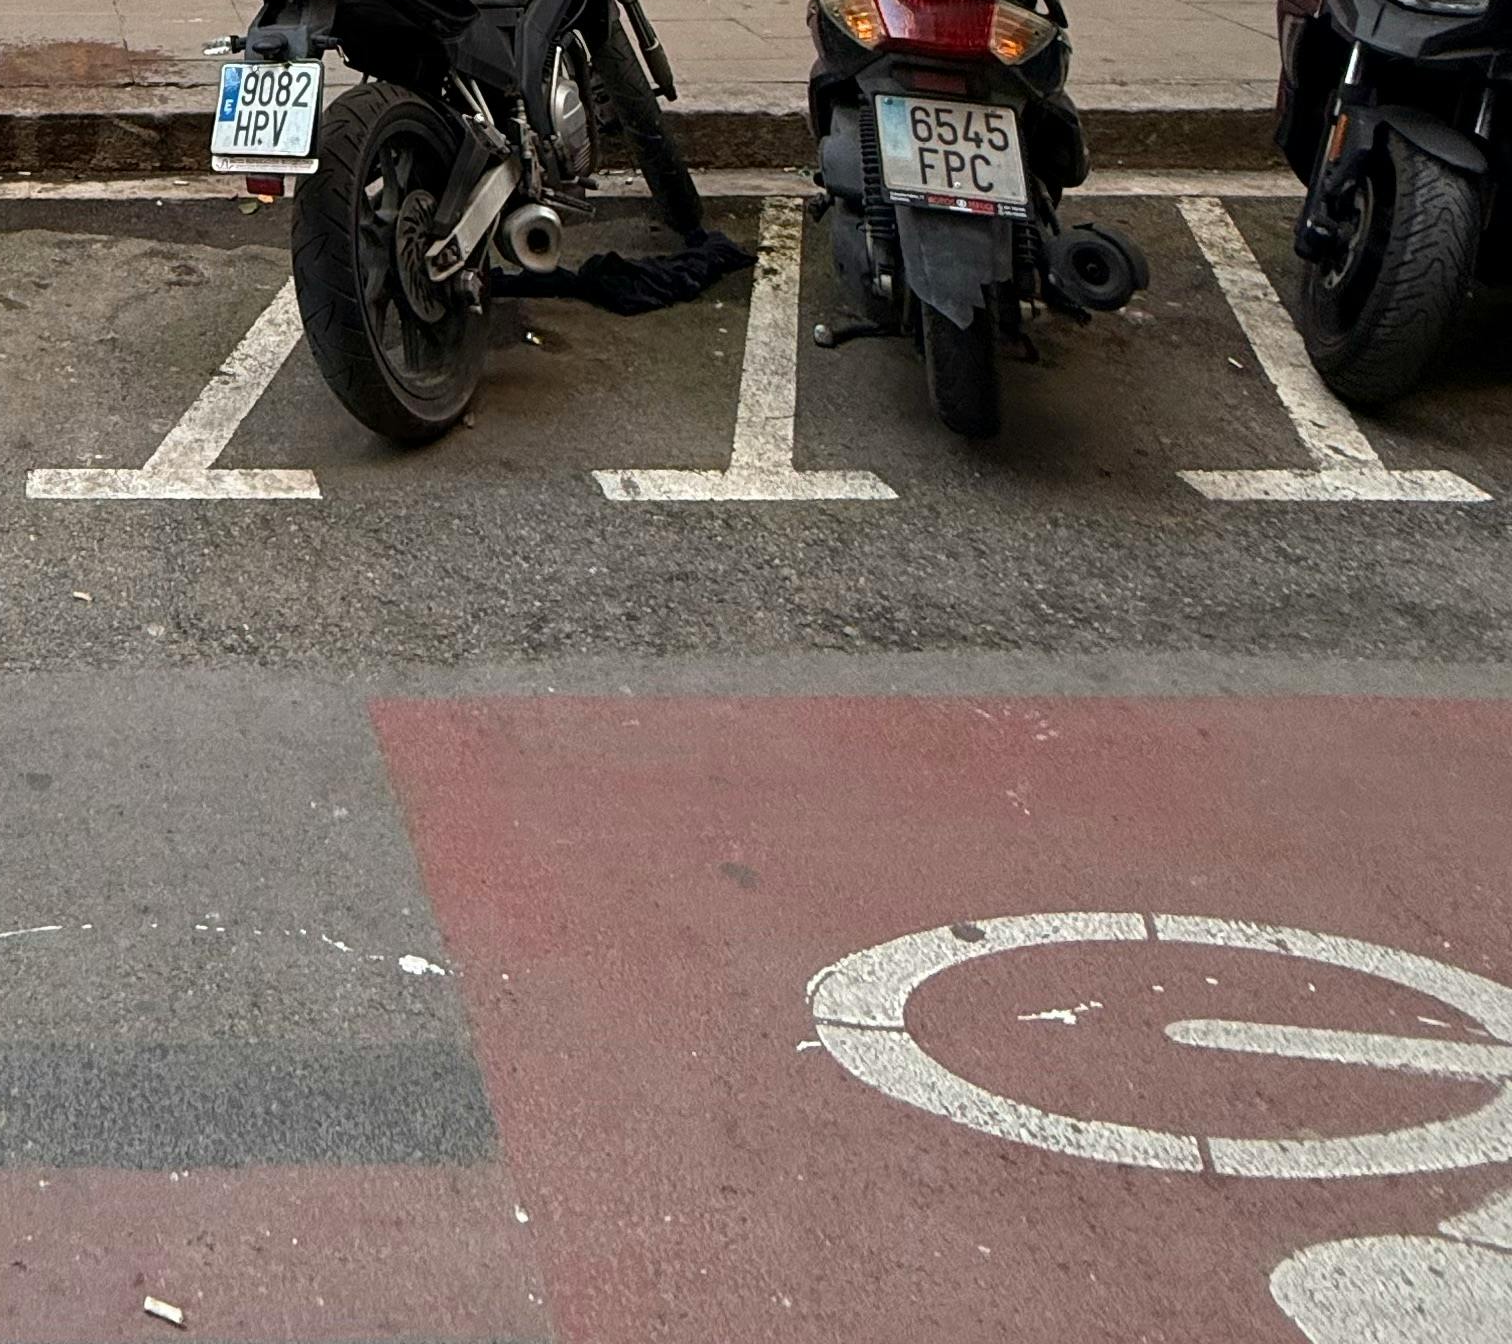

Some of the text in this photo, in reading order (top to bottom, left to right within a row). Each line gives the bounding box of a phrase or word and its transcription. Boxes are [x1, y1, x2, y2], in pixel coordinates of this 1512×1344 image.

[242, 71, 311, 108] 9082
[233, 110, 288, 147] HPV
[910, 106, 1010, 152] 6545
[919, 146, 995, 193] FPC
